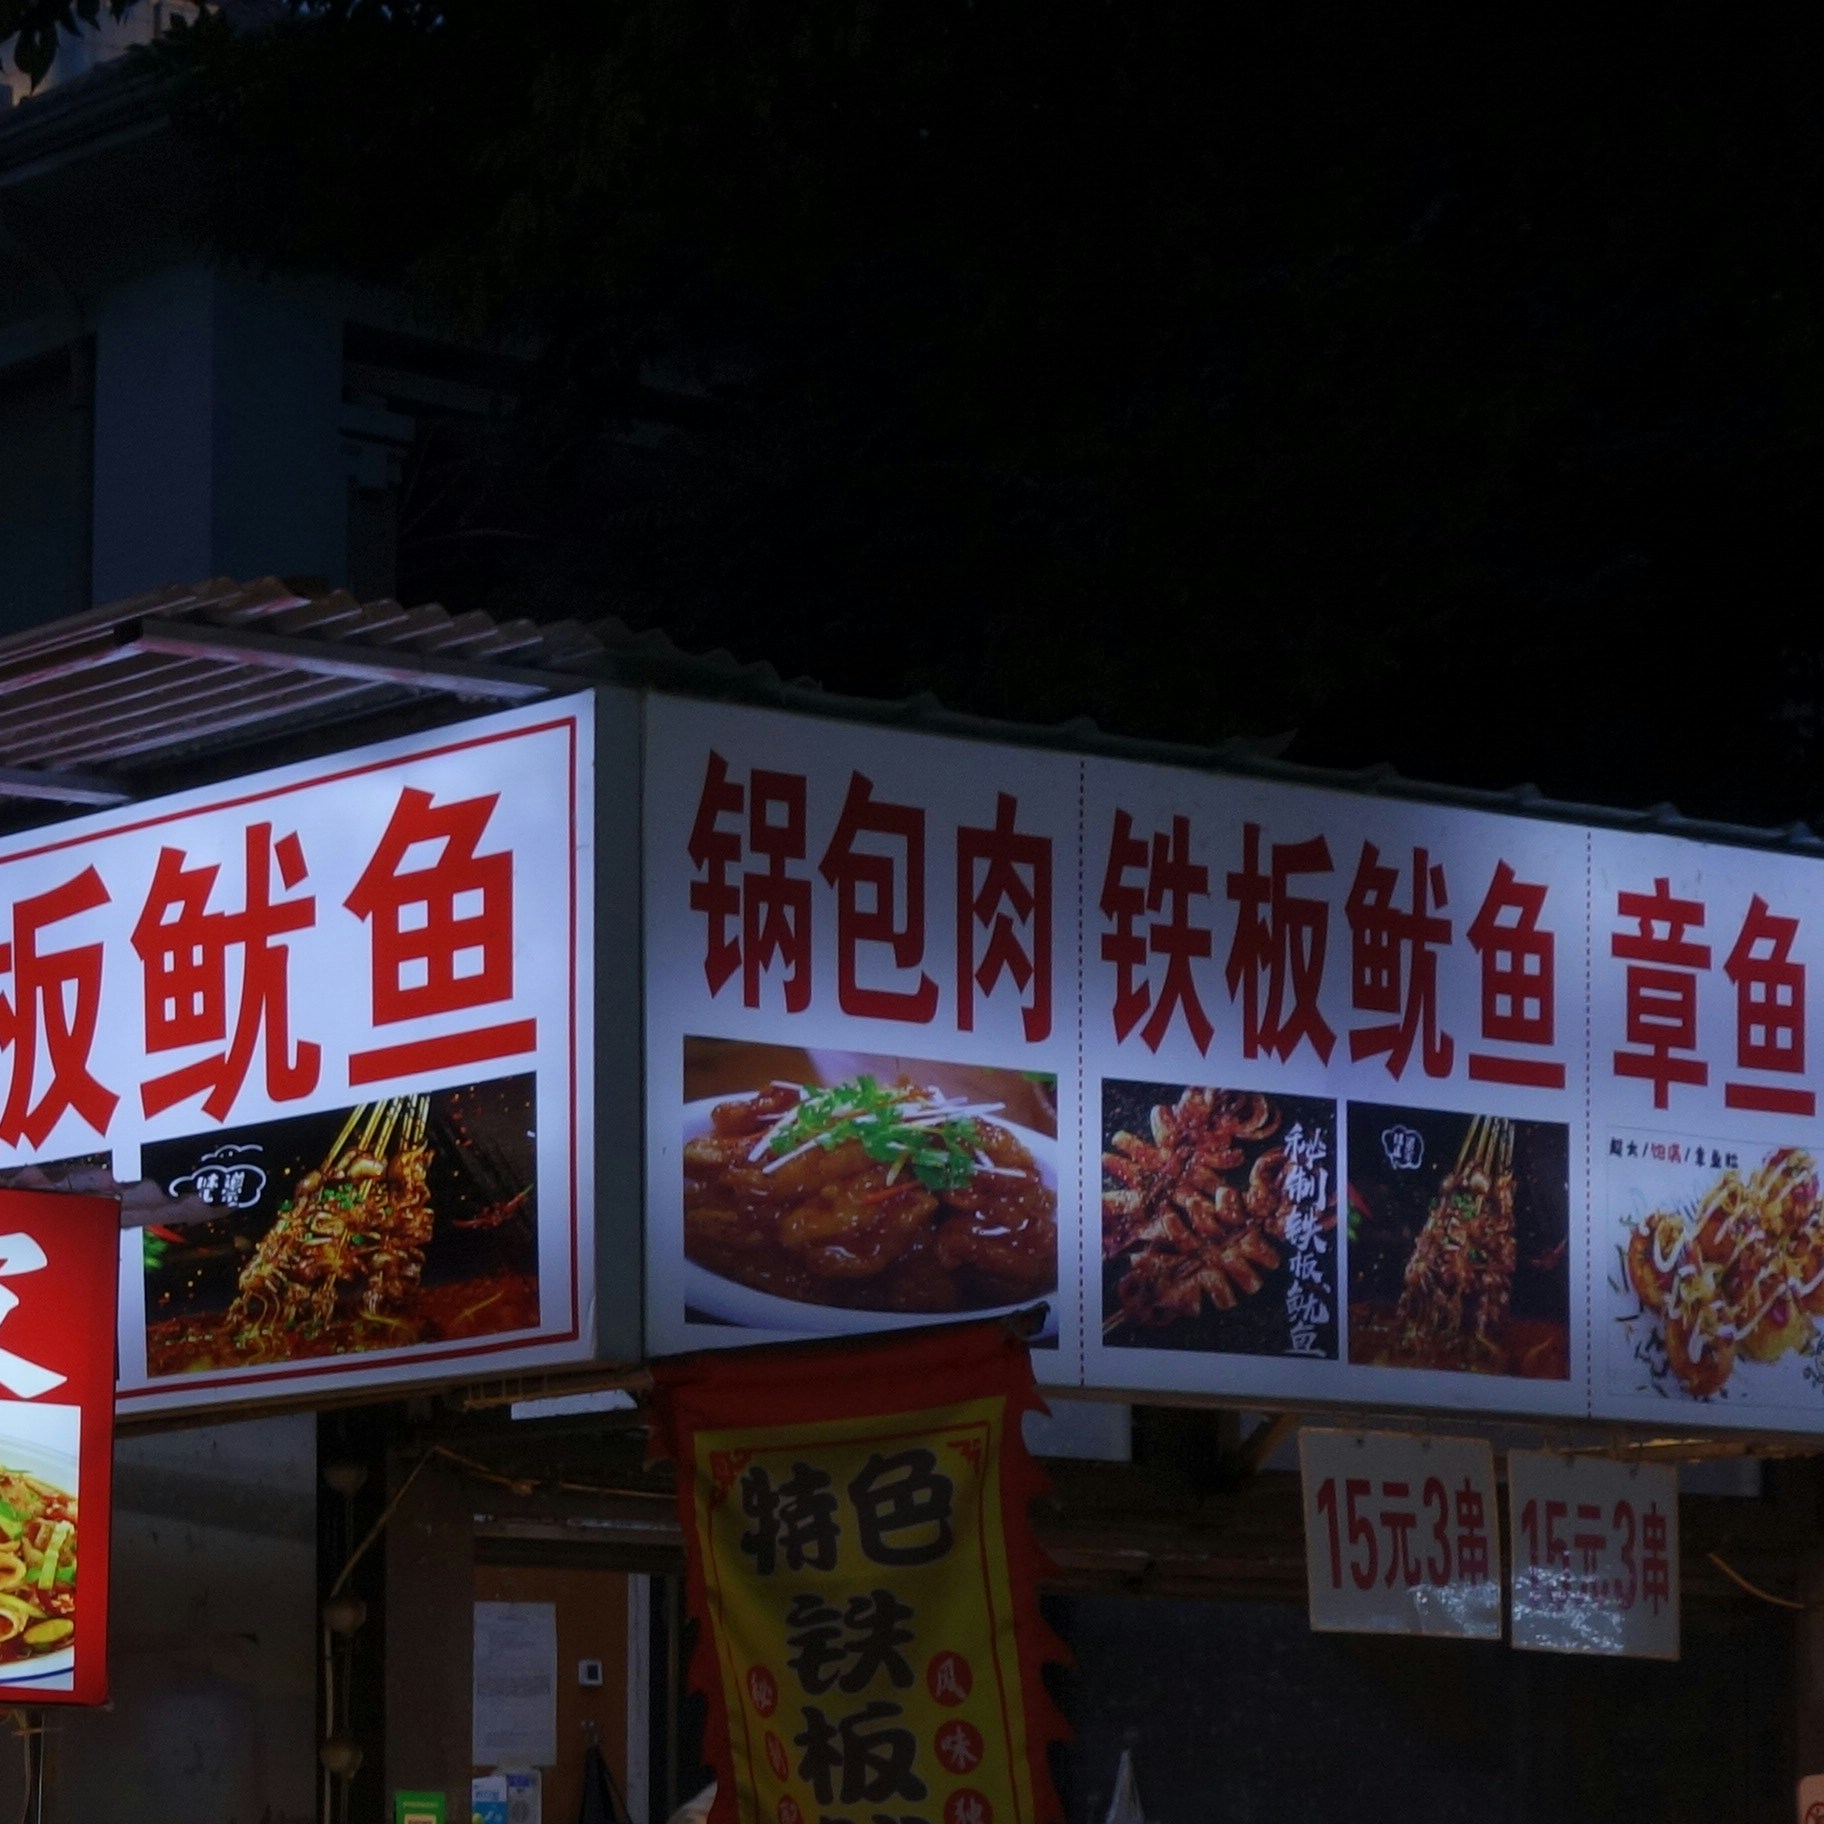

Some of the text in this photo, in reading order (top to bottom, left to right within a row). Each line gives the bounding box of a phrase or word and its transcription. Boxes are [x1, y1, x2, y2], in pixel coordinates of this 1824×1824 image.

[687, 749, 1053, 1045] 锅包肉
[1101, 806, 1567, 1091] 铁板鱿鱼
[1612, 876, 1817, 1117] 章鱼
[739, 1448, 954, 1576] 特色
